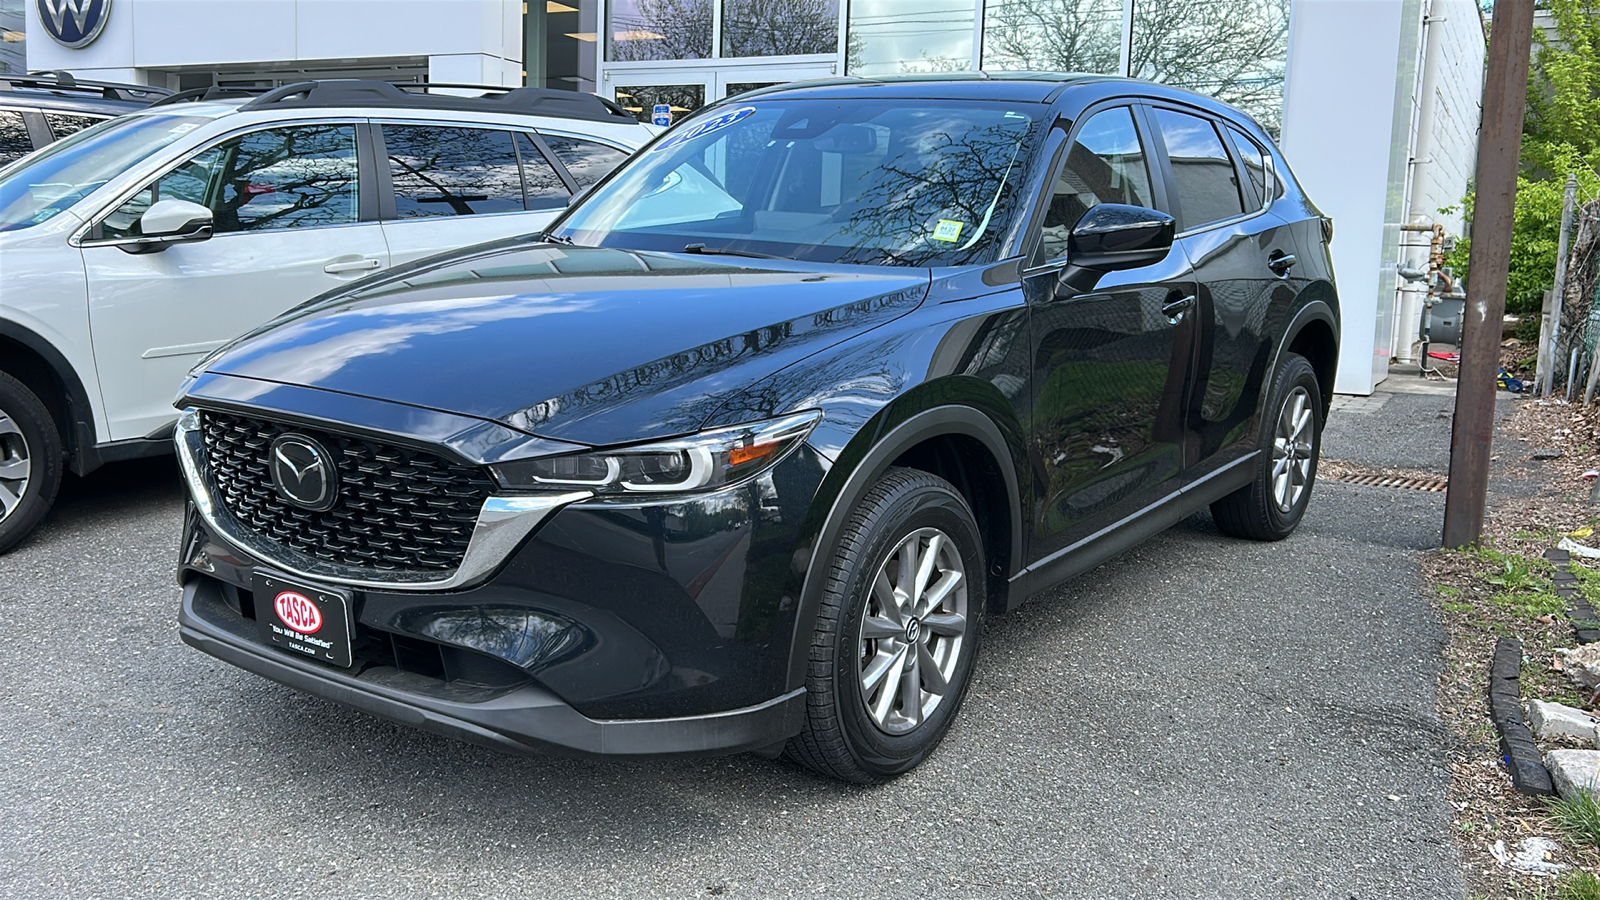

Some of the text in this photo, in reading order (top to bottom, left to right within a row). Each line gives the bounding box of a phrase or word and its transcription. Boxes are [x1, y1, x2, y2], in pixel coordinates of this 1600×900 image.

[668, 112, 740, 147] 2023
[279, 596, 316, 628] TASCA
[283, 628, 295, 638] Will
[295, 632, 303, 640] Be
[289, 642, 315, 654] TASCA.COM
